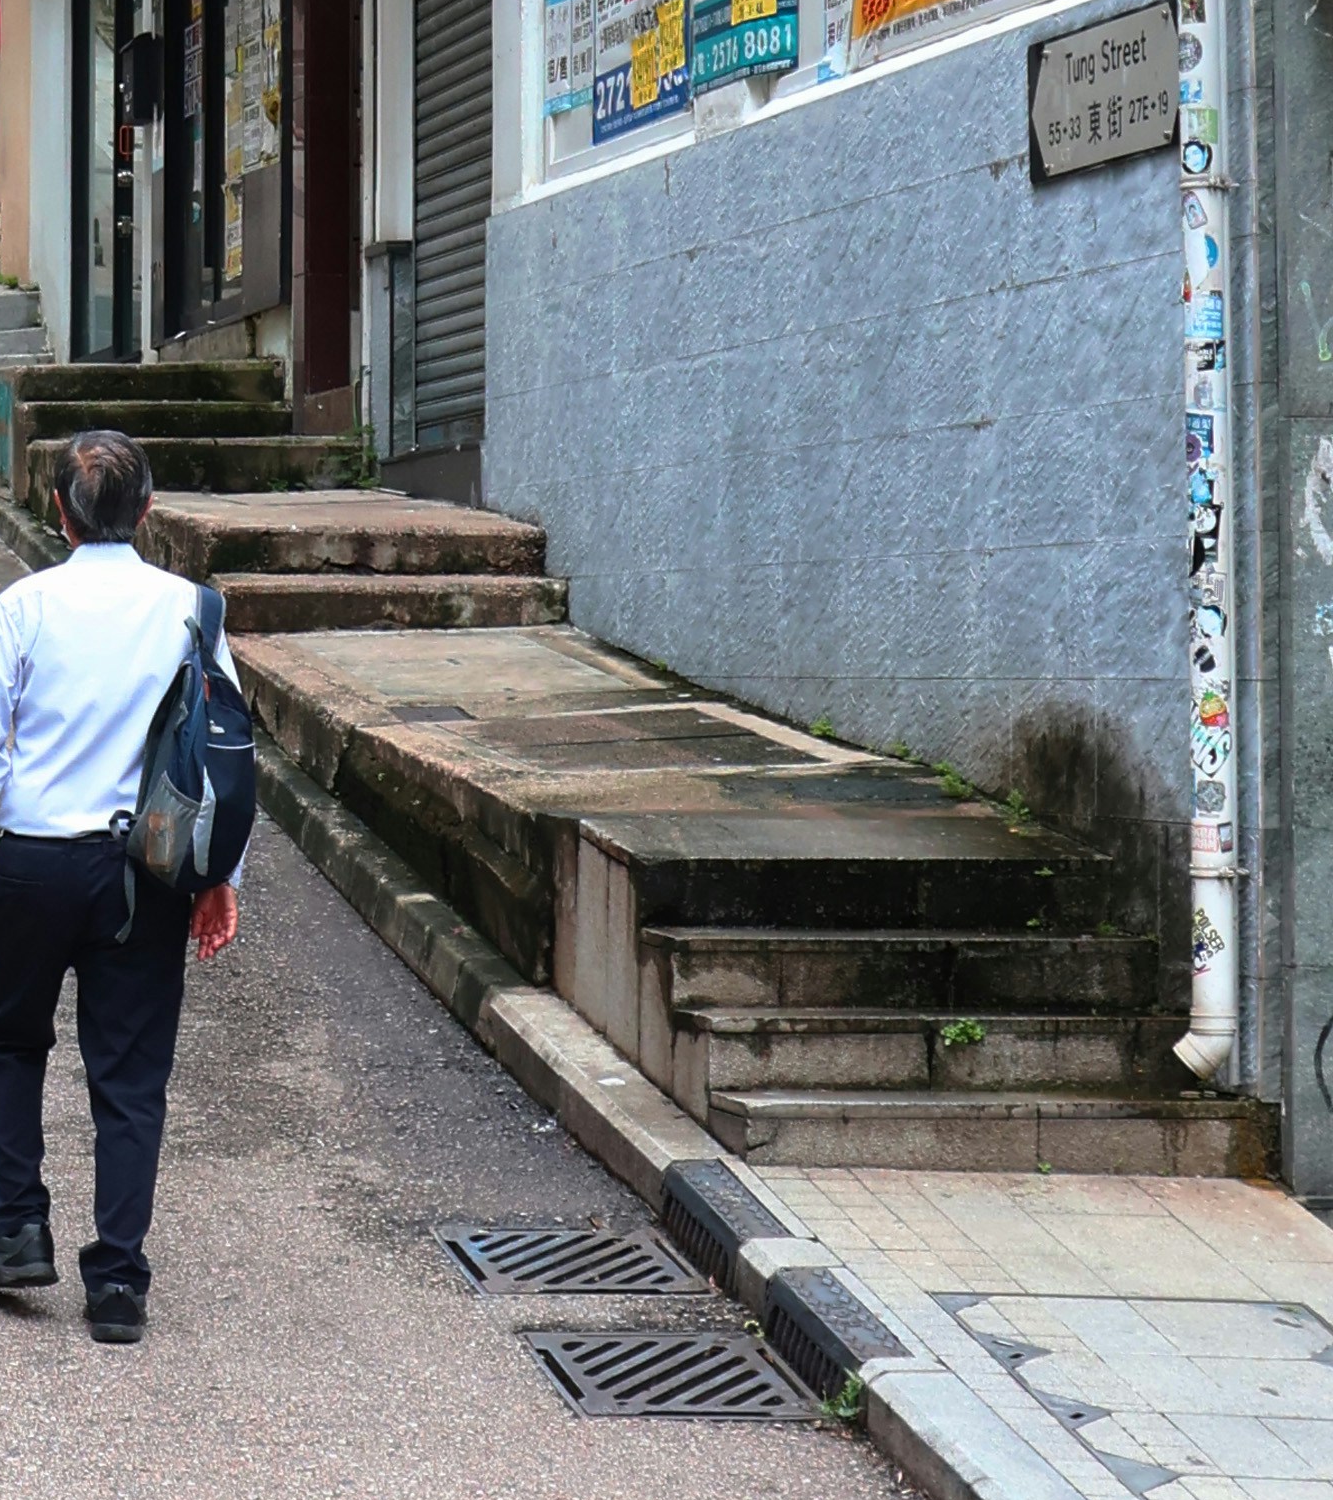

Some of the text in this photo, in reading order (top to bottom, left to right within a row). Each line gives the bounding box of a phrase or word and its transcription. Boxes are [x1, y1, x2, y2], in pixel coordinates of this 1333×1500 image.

[712, 35, 738, 72] 2576
[744, 23, 791, 59] 8081
[1065, 29, 1147, 85] Tung Street
[1087, 95, 1122, 145] 東街
